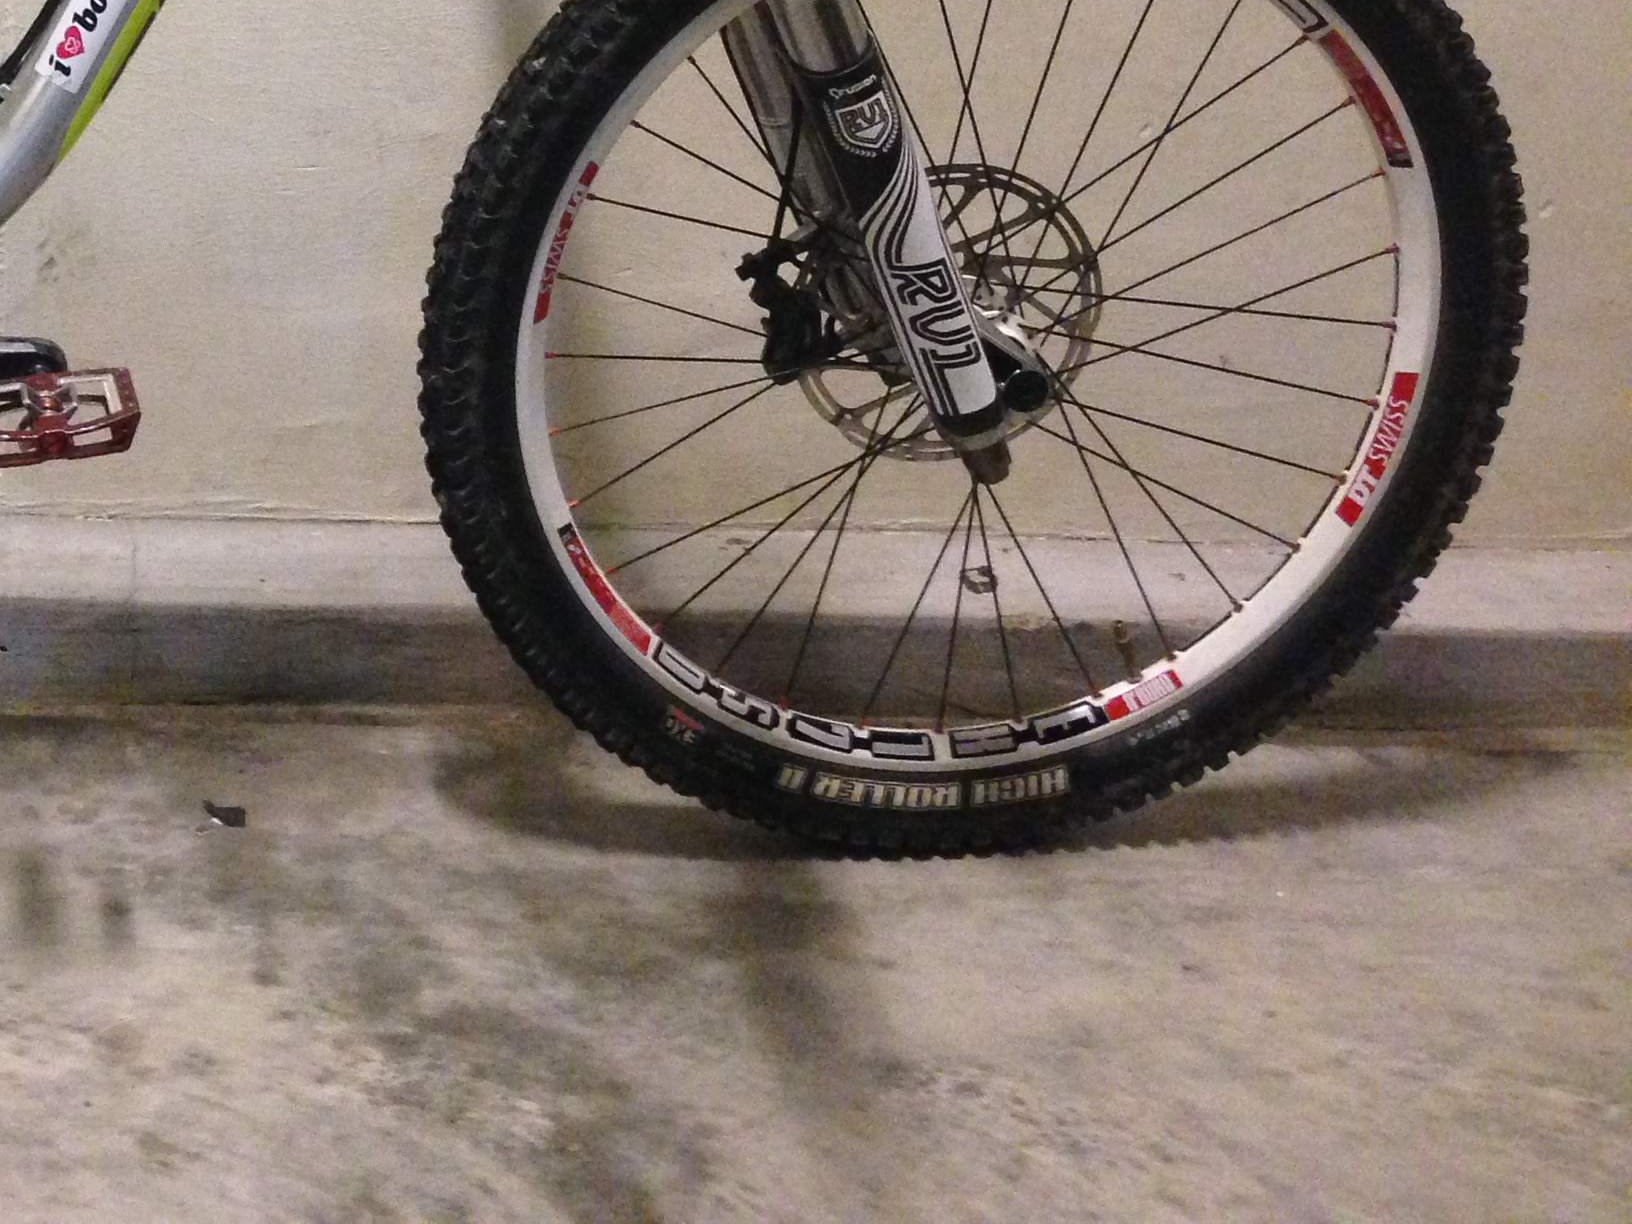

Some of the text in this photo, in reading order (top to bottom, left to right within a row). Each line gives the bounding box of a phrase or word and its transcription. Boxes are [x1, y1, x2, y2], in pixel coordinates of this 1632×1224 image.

[49, 54, 72, 77] i
[1346, 394, 1410, 508] DT SWISS
[811, 773, 961, 808] ROLLER
[972, 767, 1067, 806] HIGH
